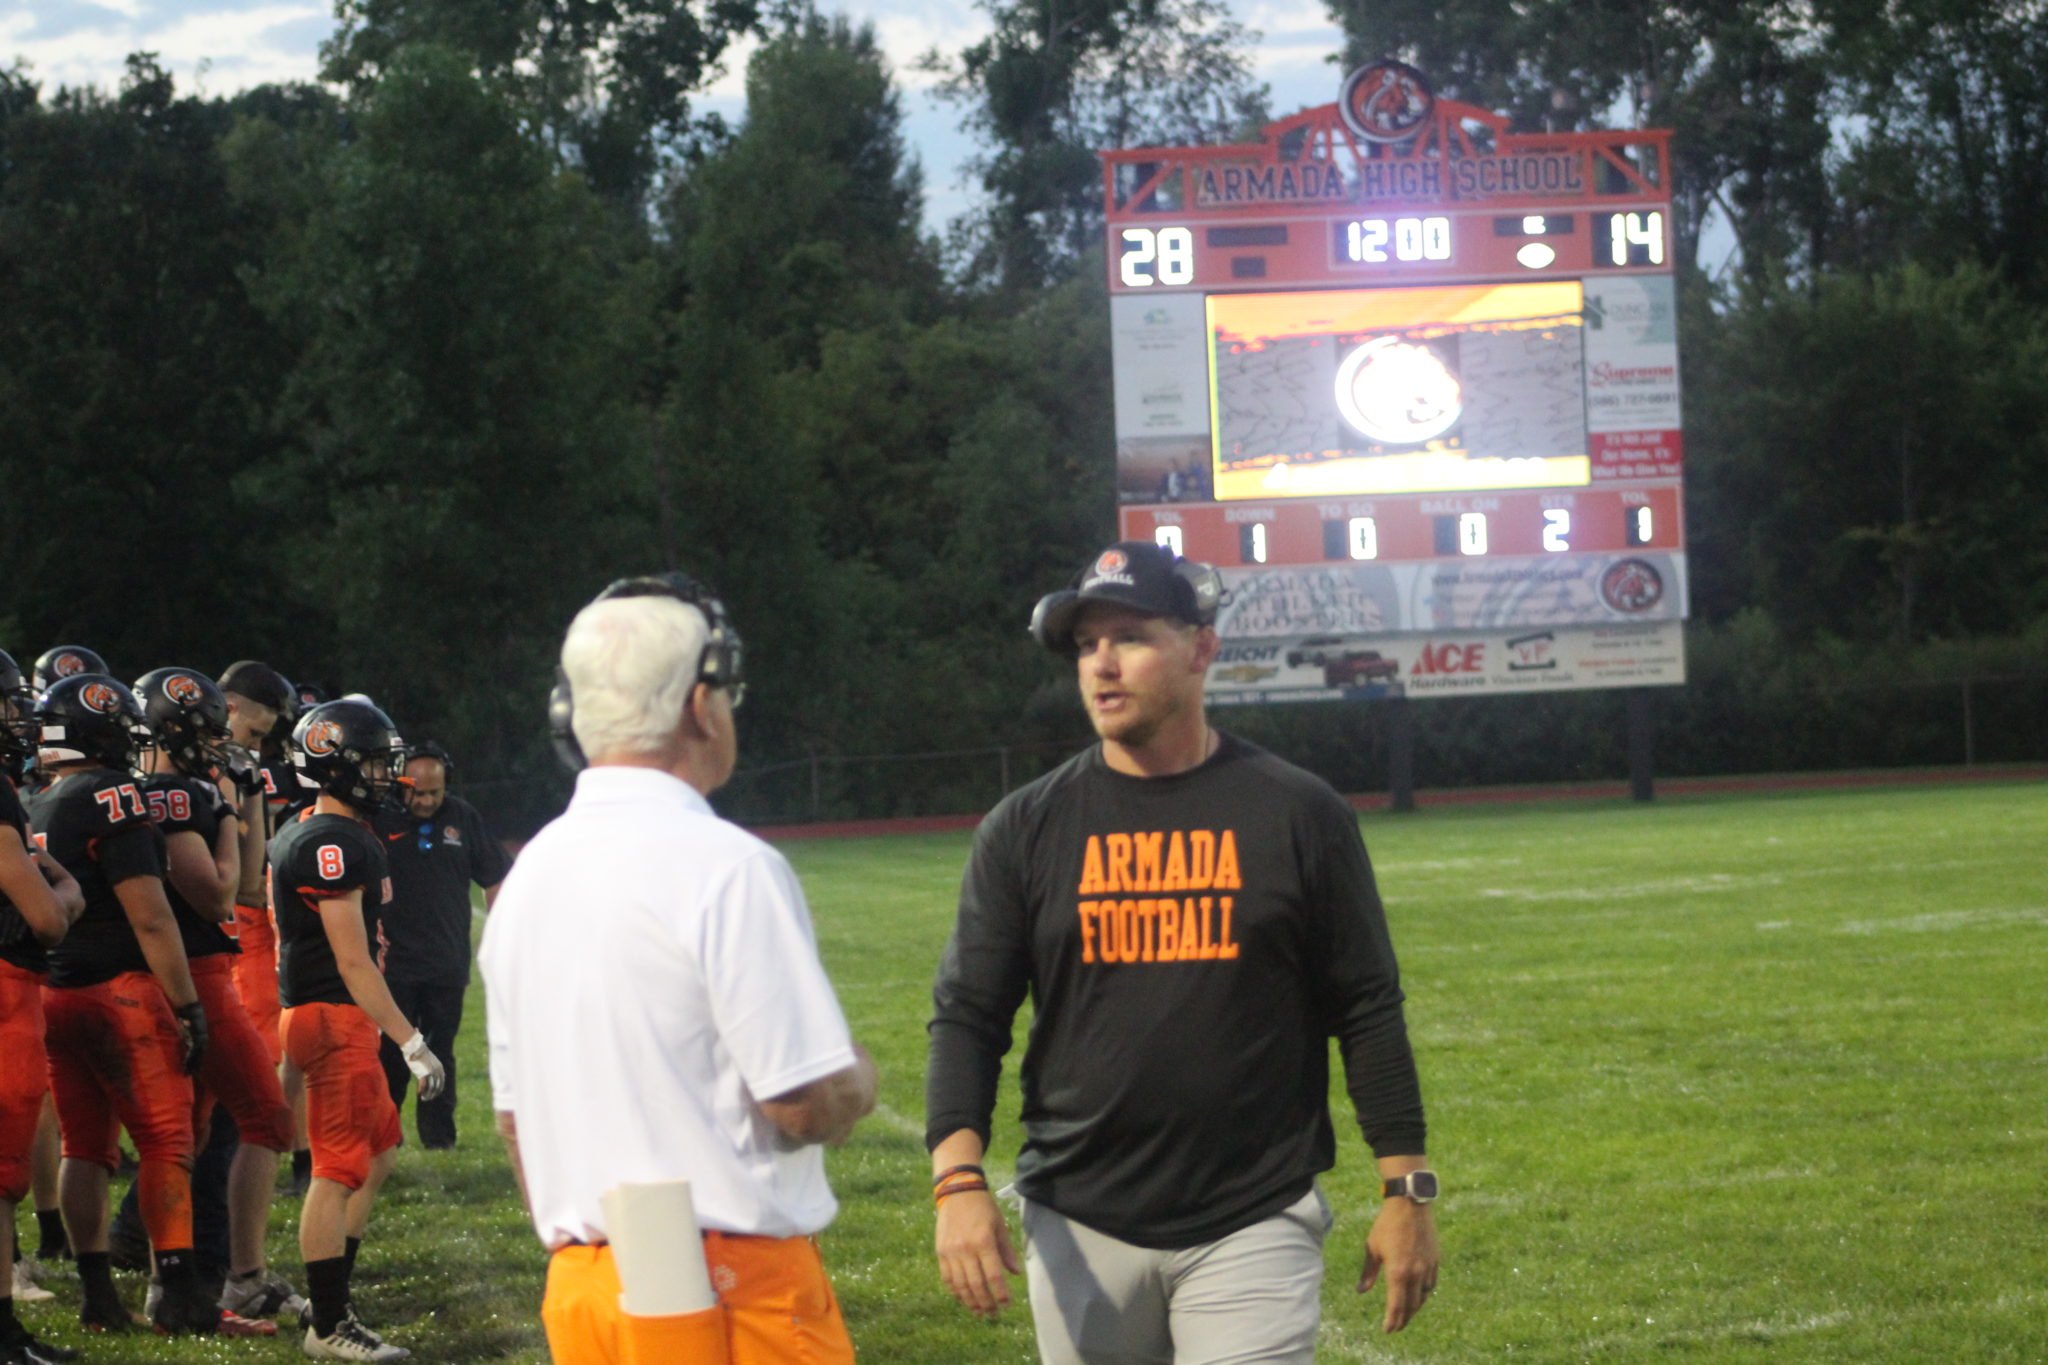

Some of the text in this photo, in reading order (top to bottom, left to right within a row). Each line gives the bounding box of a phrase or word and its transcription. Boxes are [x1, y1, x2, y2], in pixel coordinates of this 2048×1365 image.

[1202, 155, 1582, 200] ARMADA HIGH SCHOOL
[1120, 227, 1194, 287] 28
[1611, 212, 1664, 266] 14
[1224, 507, 1275, 523] DOWN
[1317, 503, 1376, 519] TO GO
[1419, 498, 1500, 514] BALL ON
[1620, 491, 1649, 504] TOL
[1153, 511, 1183, 524] TOL
[1459, 512, 1488, 555] 0
[1542, 508, 1571, 552] 2
[1638, 506, 1653, 542] 1
[1252, 523, 1267, 563] 1
[1349, 517, 1378, 560] 0
[1410, 640, 1486, 675] ACE
[1410, 675, 1486, 690] Hardware
[94, 783, 146, 824] 77
[146, 789, 191, 823] 58
[316, 844, 345, 881] 8
[1078, 829, 1242, 895] ARMADA
[1078, 896, 1239, 964] FOOTBALL
